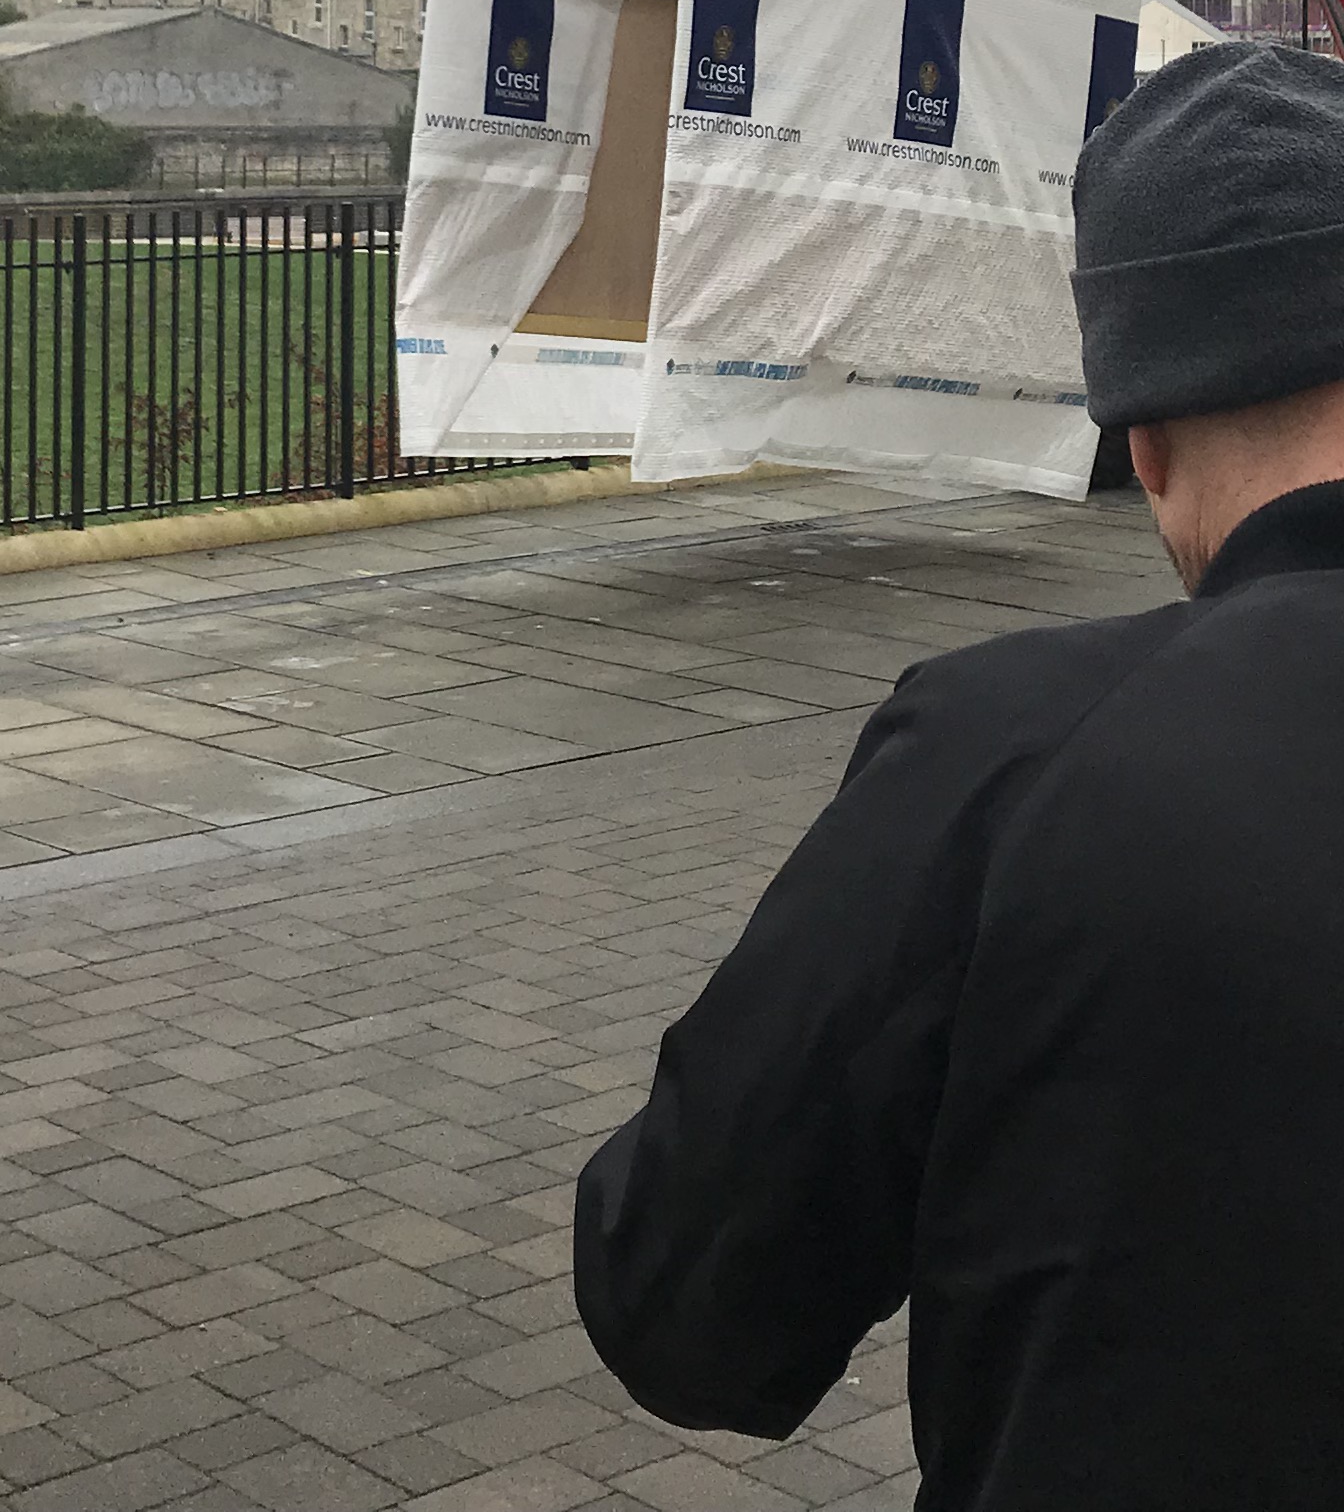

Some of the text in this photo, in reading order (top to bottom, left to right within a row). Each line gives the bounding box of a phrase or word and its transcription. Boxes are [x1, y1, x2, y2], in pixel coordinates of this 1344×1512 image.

[494, 65, 540, 92] Crest
[697, 56, 746, 84] Crest
[696, 80, 746, 95] NICHOLSON
[906, 89, 950, 117] Crest
[425, 112, 591, 146] www.crestnicholson.com
[905, 112, 947, 127] NICHOLSON
[846, 137, 1000, 175] www.crestnicholson.com
